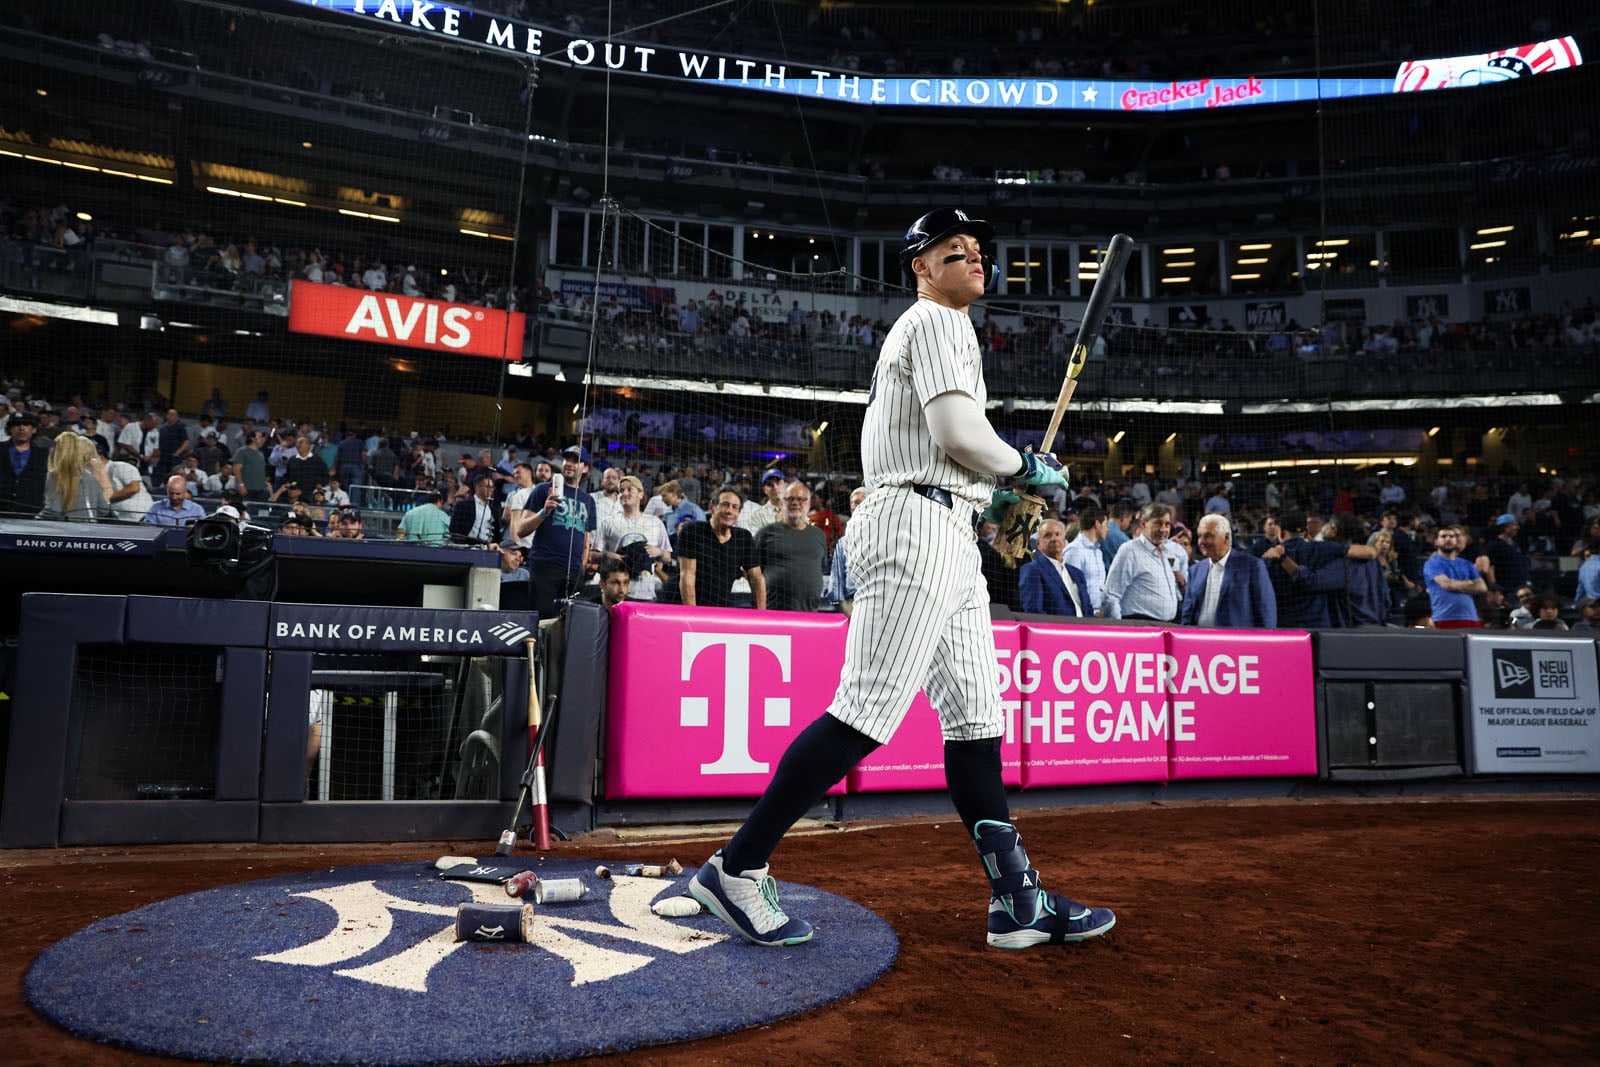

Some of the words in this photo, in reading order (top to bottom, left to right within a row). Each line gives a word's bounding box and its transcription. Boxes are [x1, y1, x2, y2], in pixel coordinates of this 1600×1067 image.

[486, 19, 543, 56] ME
[567, 39, 655, 72] OUT
[679, 52, 786, 89] WITH
[811, 70, 886, 101] THE
[910, 79, 1059, 105] CROWD
[1121, 80, 1211, 111] Cracker
[1206, 76, 1263, 108] Jack
[726, 290, 782, 305] DELTA
[16, 539, 46, 548] BANK
[65, 542, 114, 551] AMERICA
[276, 622, 341, 639] BANK
[347, 624, 377, 640] OF
[382, 625, 483, 644] AMERICA
[994, 649, 1042, 695] 5G
[1052, 650, 1260, 695] COVERAGE
[1539, 660, 1569, 674] NEW
[1540, 674, 1570, 689] ERA
[1479, 707, 1495, 715] THE
[1496, 707, 1532, 715] OFFICIAL
[1533, 707, 1568, 715] ON-FIELD
[1569, 707, 1585, 716] CAP
[1586, 708, 1597, 716] OF
[1003, 700, 1075, 745] THE
[1086, 700, 1196, 743] GAME
[1488, 718, 1516, 726] MAJOR
[1516, 718, 1547, 726] LEAGUE
[1548, 718, 1588, 726] BASEBALL
